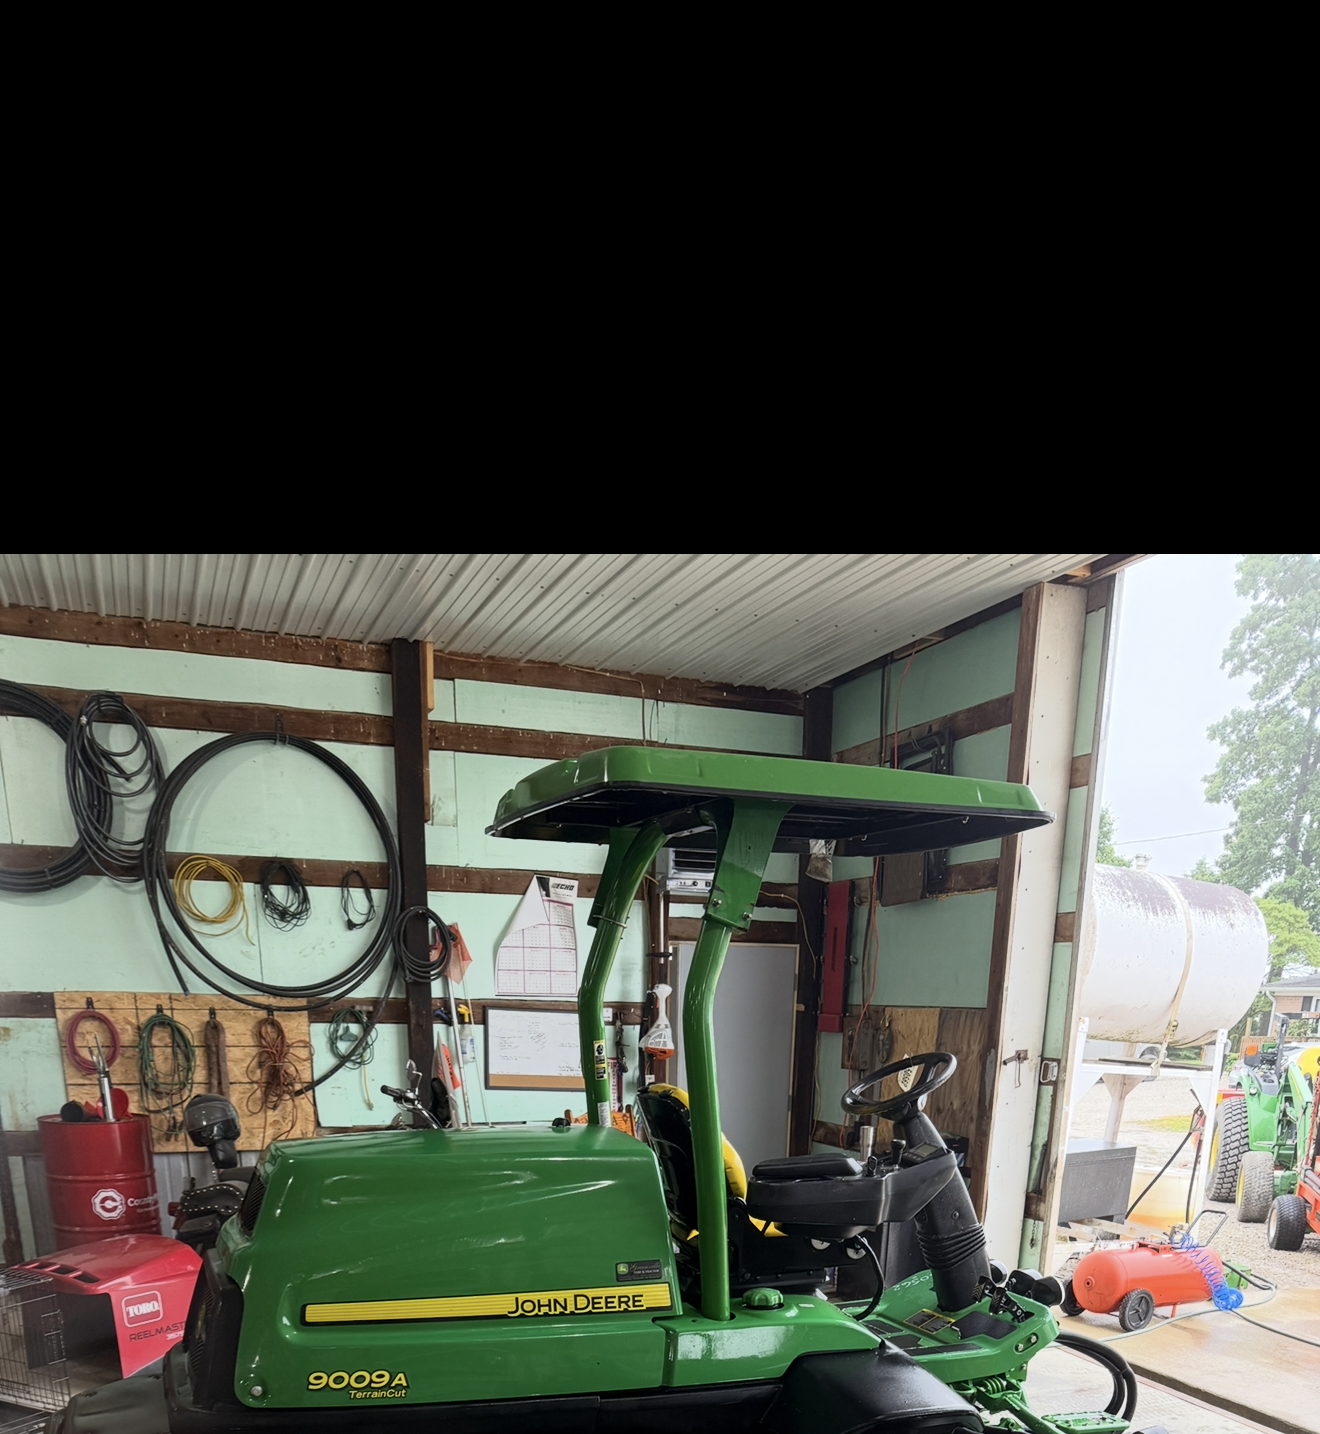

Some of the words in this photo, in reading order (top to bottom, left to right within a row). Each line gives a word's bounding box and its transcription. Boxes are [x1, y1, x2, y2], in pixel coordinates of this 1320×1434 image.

[555, 883, 575, 891] ECHO
[507, 1296, 568, 1315] JOHN
[573, 1293, 645, 1311] DEERE
[129, 1321, 186, 1341] REELMAST
[348, 1388, 407, 1399] TerrainCut
